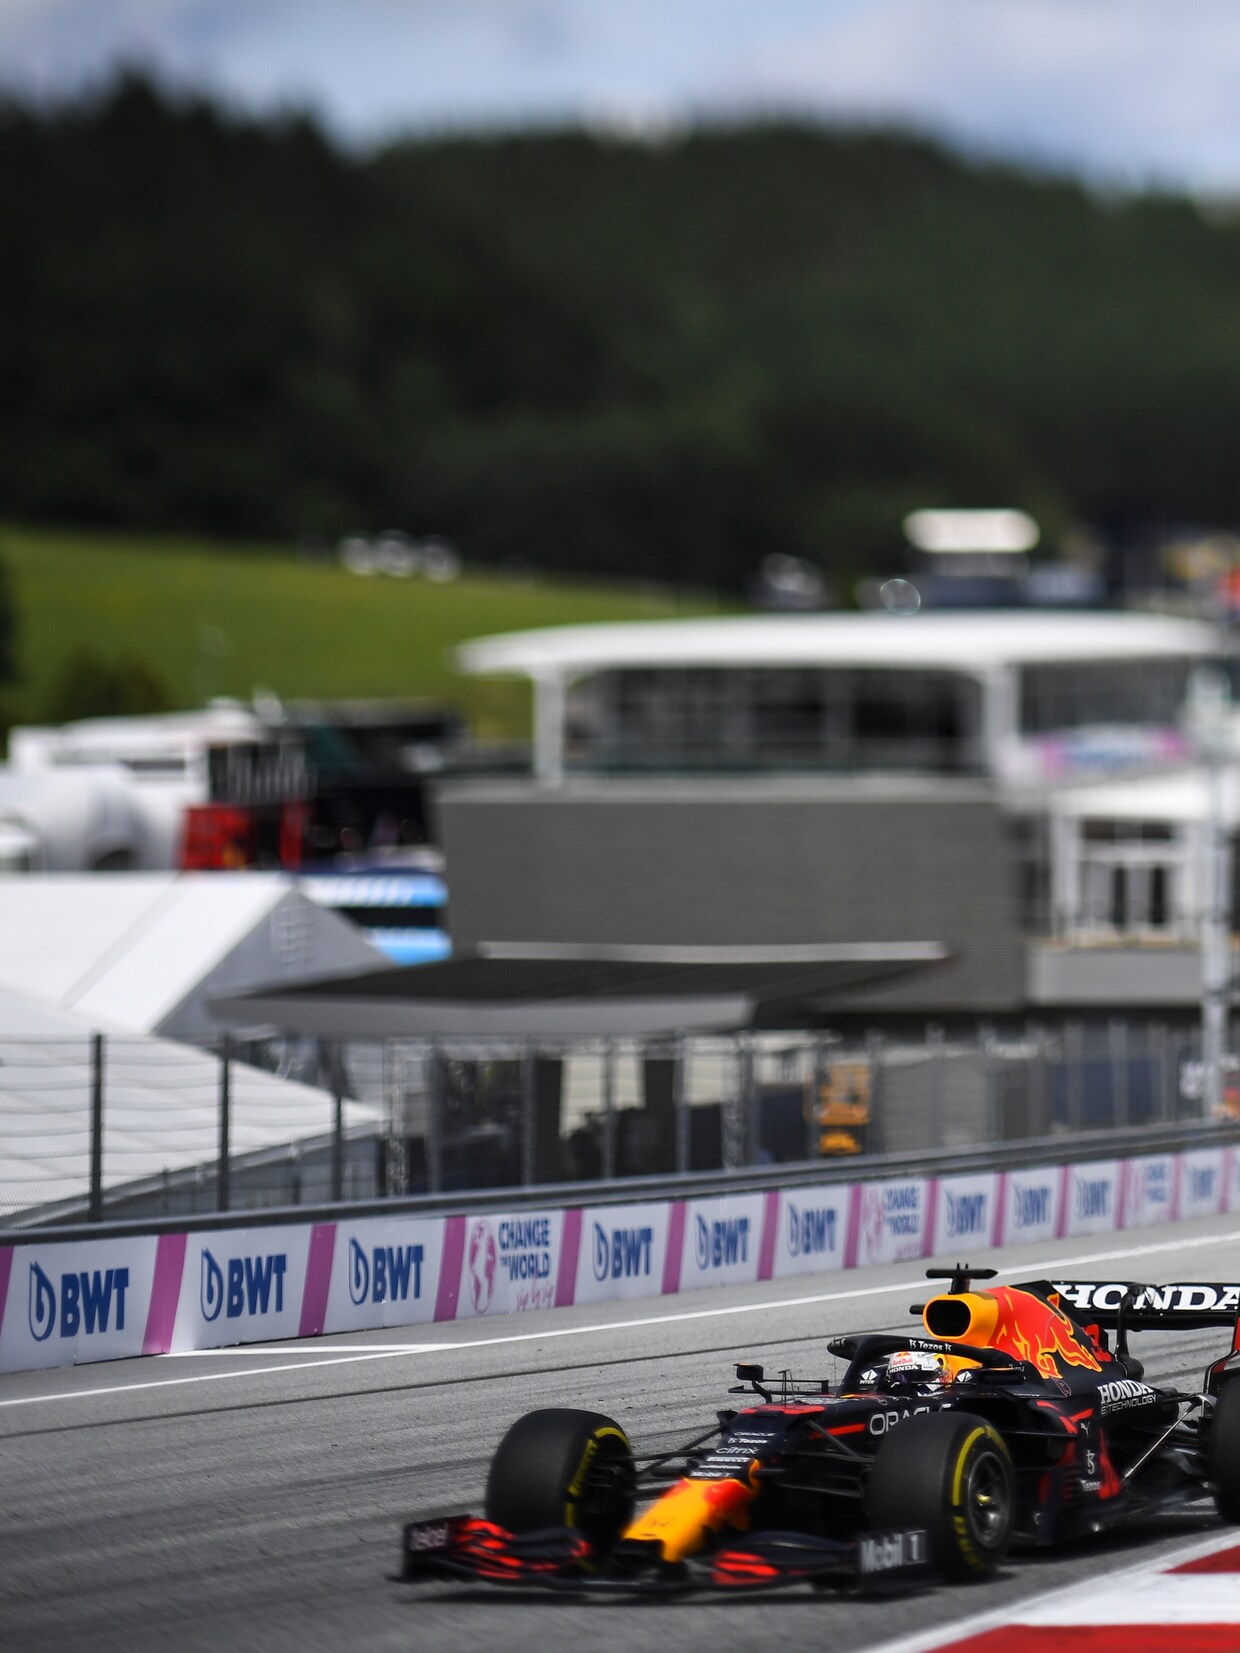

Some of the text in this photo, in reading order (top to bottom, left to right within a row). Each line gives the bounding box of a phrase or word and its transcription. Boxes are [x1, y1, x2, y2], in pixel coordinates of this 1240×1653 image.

[500, 1218, 549, 1250] CHANGE
[712, 1217, 750, 1268] BWT
[509, 1252, 550, 1280] WORLD
[611, 1228, 654, 1278] BWT
[227, 1253, 287, 1319] BWT
[371, 1244, 424, 1302] BWT
[60, 1267, 129, 1338] BWT
[1052, 1284, 1240, 1310] HONDA
[919, 1341, 943, 1351] Tezos
[889, 1364, 919, 1374] HONDA
[1097, 1379, 1154, 1405] HONDA
[861, 1533, 902, 1573] Mobil
